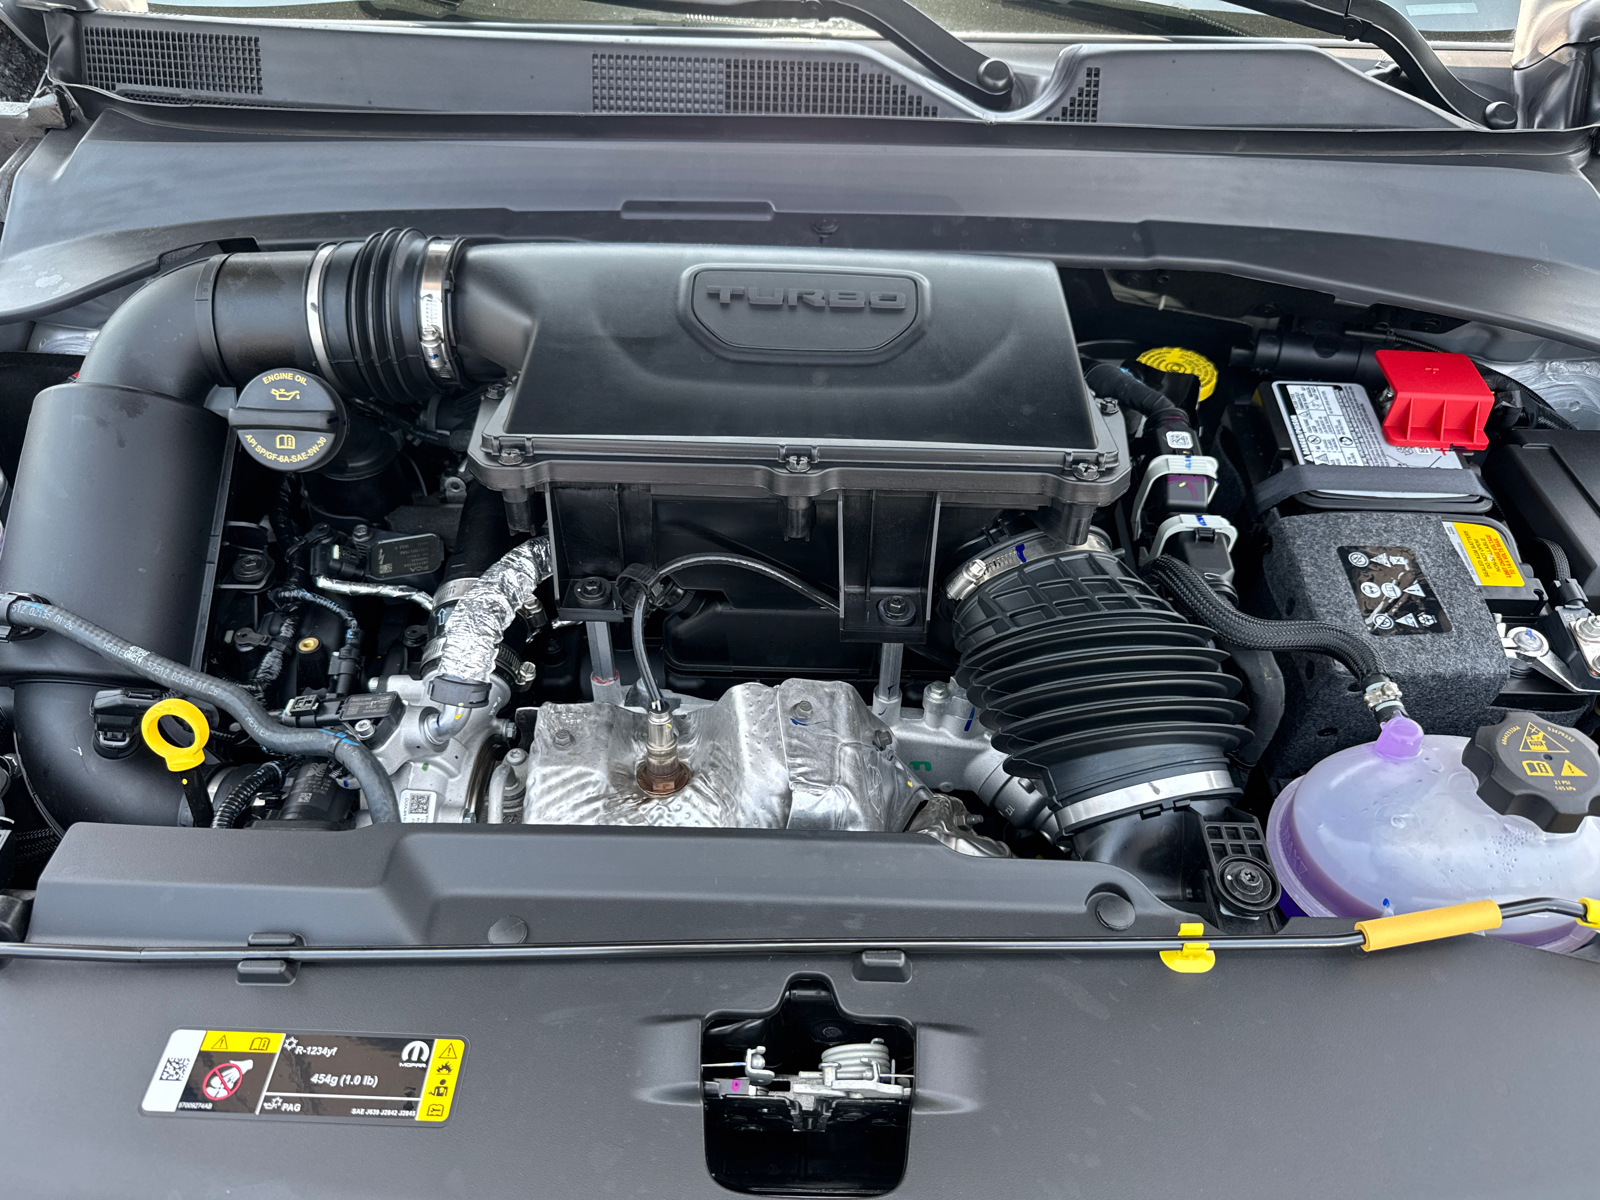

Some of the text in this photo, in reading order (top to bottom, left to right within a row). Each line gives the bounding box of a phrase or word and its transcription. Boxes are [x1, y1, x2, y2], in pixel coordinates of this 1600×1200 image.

[706, 285, 907, 310] TURBO
[262, 373, 307, 386] ENGINE OIL
[245, 434, 257, 447] API
[1462, 530, 1476, 549] BATTERY
[1473, 549, 1481, 559] AGM
[1478, 559, 1490, 578] SEALED
[295, 1046, 338, 1057] R-1234yf
[310, 1073, 378, 1088] 454g (1.0 lb)
[281, 1103, 301, 1112] PAG
